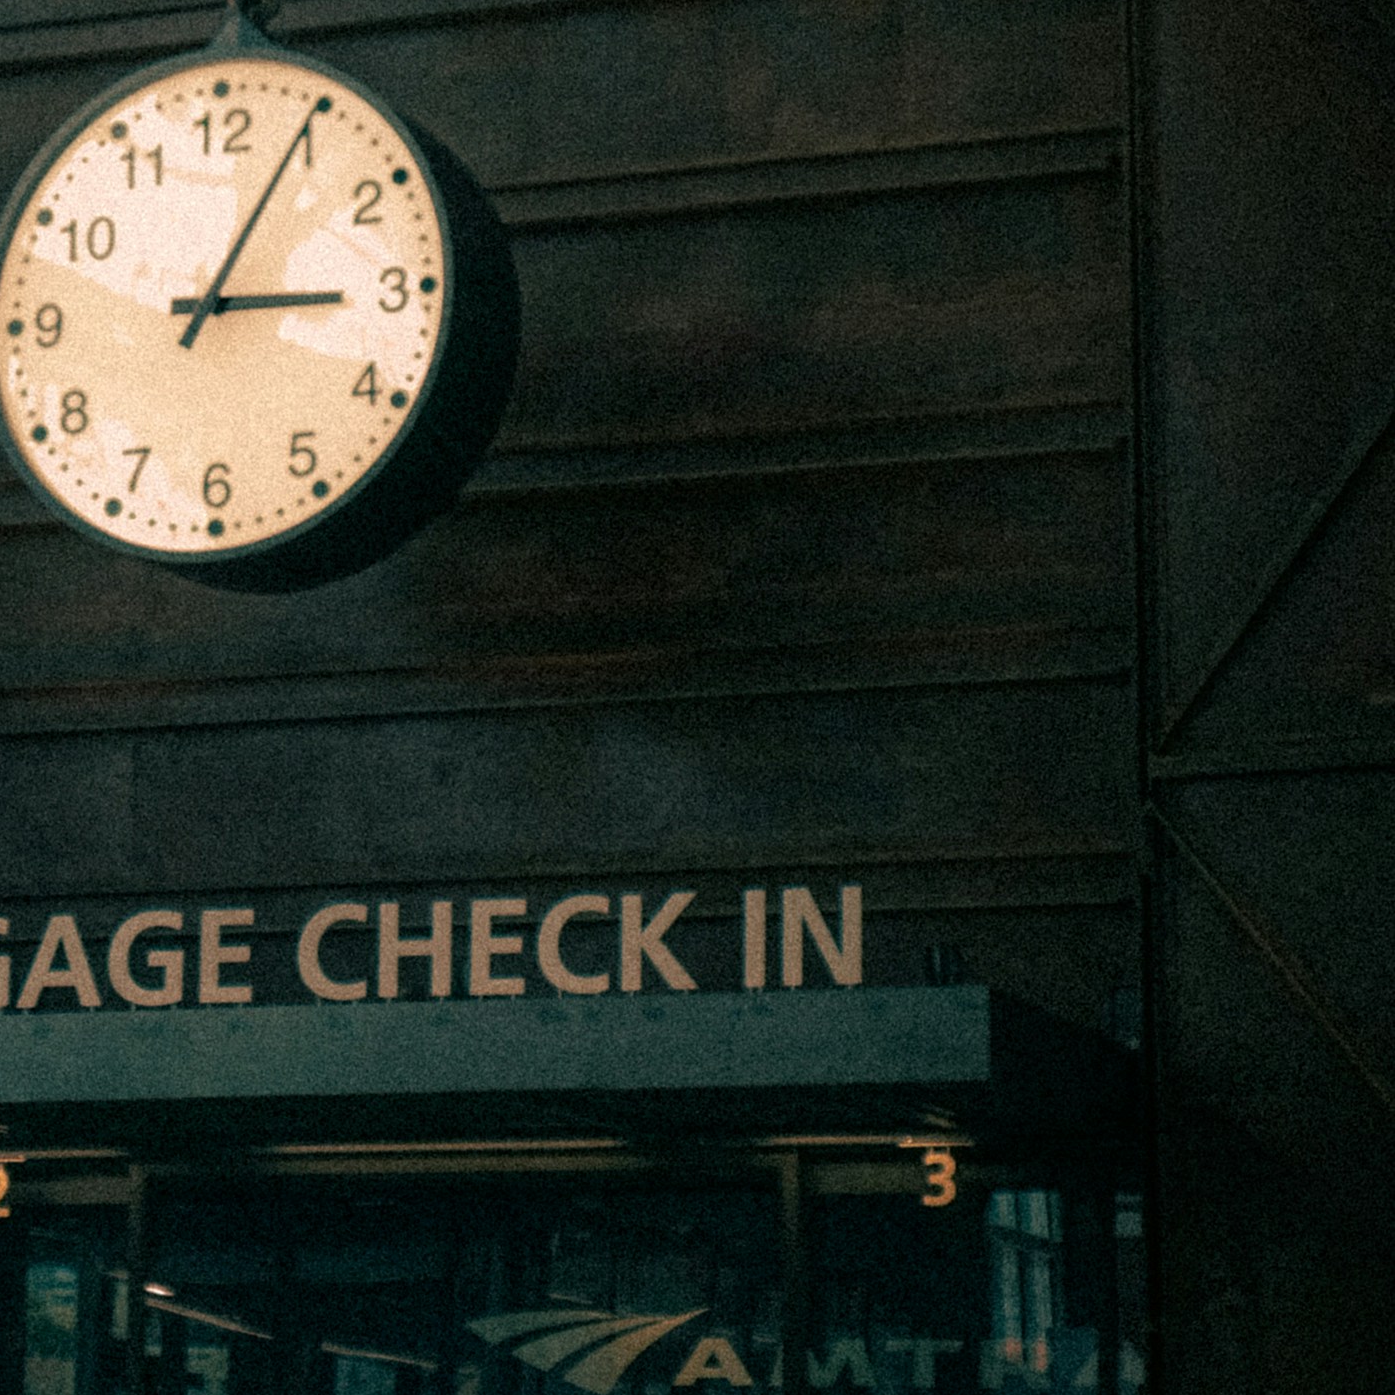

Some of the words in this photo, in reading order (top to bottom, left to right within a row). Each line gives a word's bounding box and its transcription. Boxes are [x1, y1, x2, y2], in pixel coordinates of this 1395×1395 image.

[193, 109, 253, 156] 12
[300, 120, 312, 169] 1
[121, 145, 164, 190] 11
[353, 181, 383, 226] 2
[59, 217, 116, 262] 10
[379, 267, 409, 313] 3
[35, 304, 64, 349] 9
[352, 362, 381, 407] 4
[60, 390, 88, 435] 8
[122, 447, 152, 493] 7
[288, 432, 317, 477] 5
[203, 463, 232, 508] 6
[297, 892, 697, 1001] CHECK
[744, 885, 863, 990] IN
[921, 1151, 956, 1207] 3
[672, 1337, 1147, 1388] AMTRA
